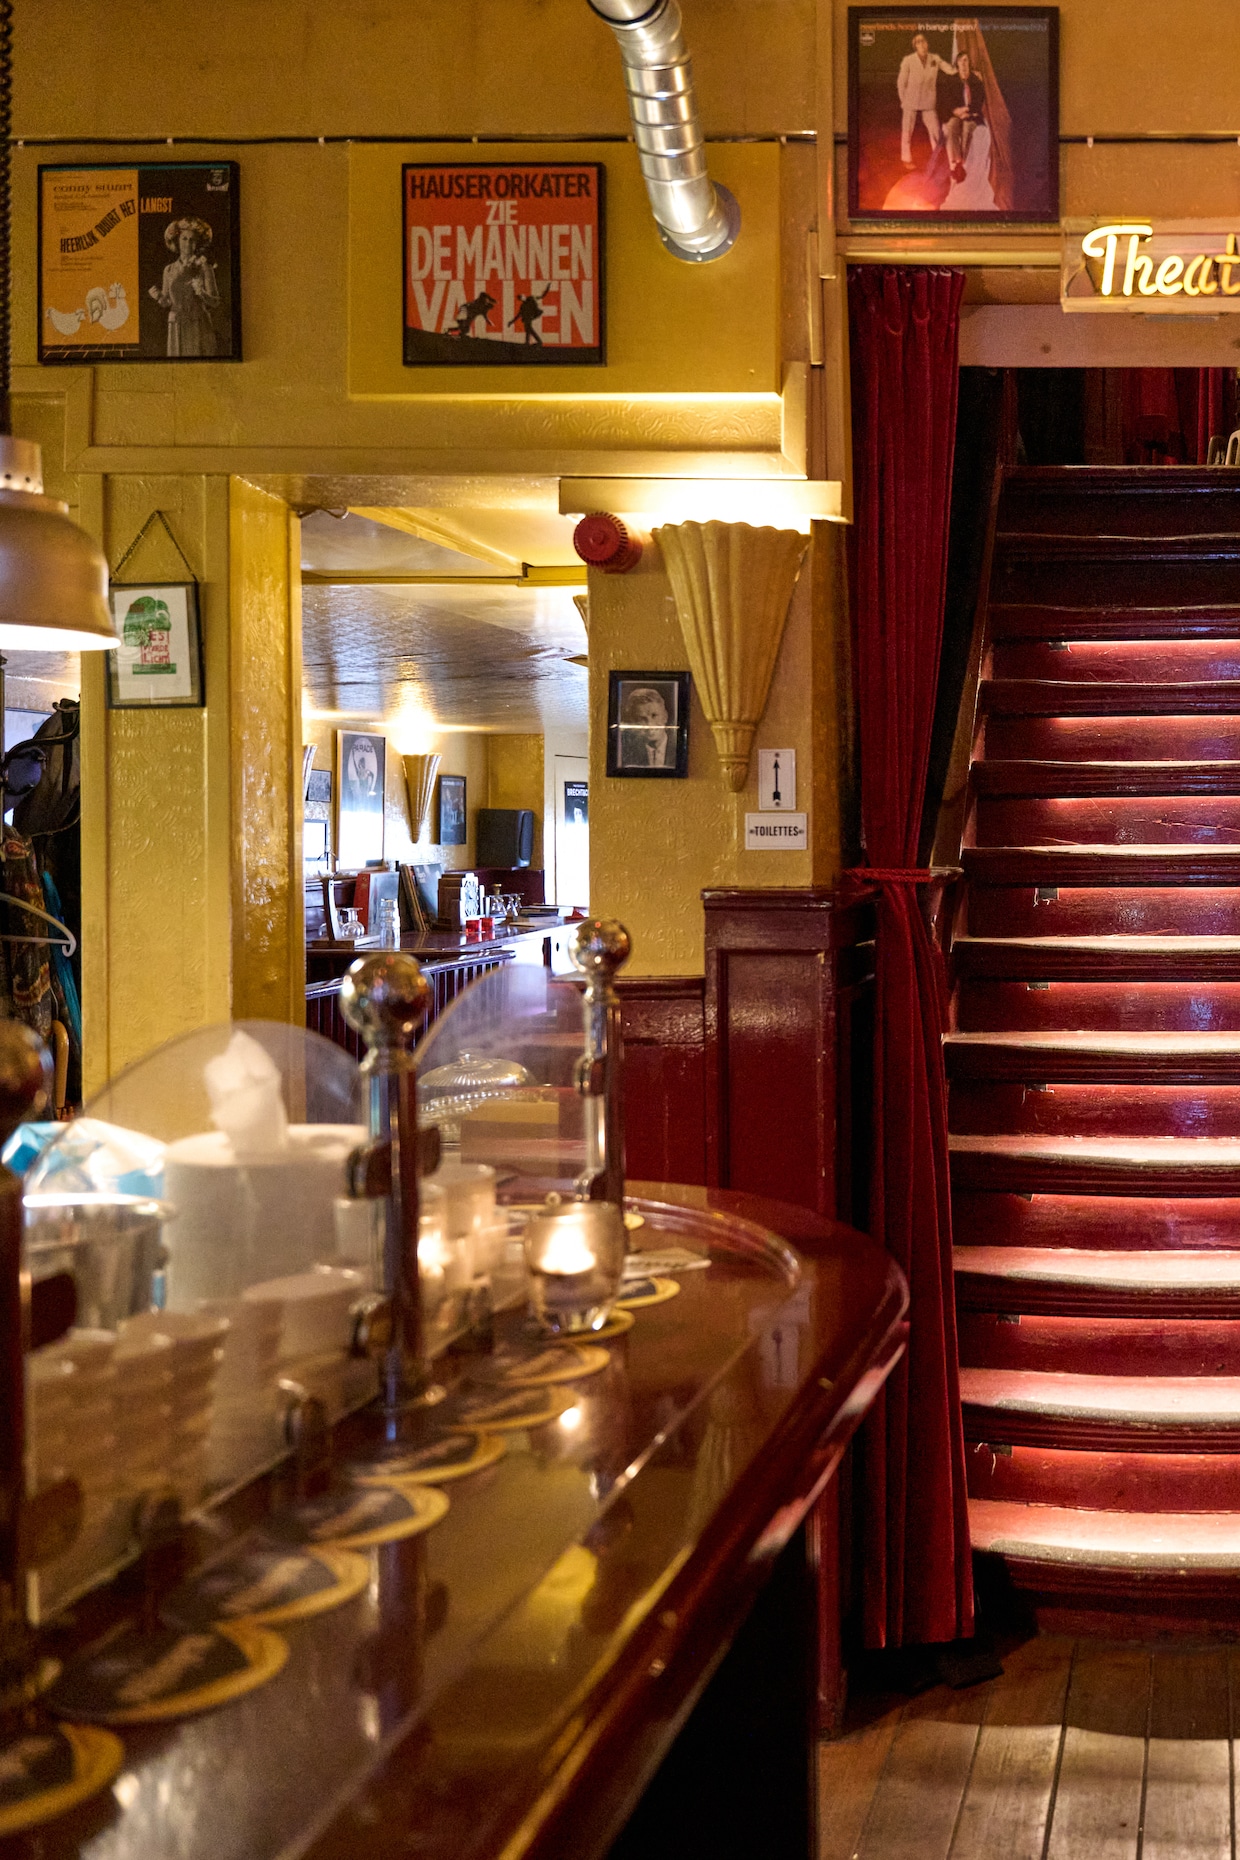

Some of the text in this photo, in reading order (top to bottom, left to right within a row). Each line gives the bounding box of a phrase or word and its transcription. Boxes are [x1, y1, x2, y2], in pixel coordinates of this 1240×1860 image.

[410, 173, 591, 199] HAUSER ORKATER
[60, 230, 99, 254] HEERLIJK
[95, 208, 122, 238] DUURT
[119, 199, 136, 219] HET
[140, 197, 173, 214] LANGST
[485, 200, 518, 225] ZIE
[411, 224, 593, 280] DE MANNEN
[411, 280, 593, 344] VALLEN
[754, 826, 799, 837] TOILETTES
